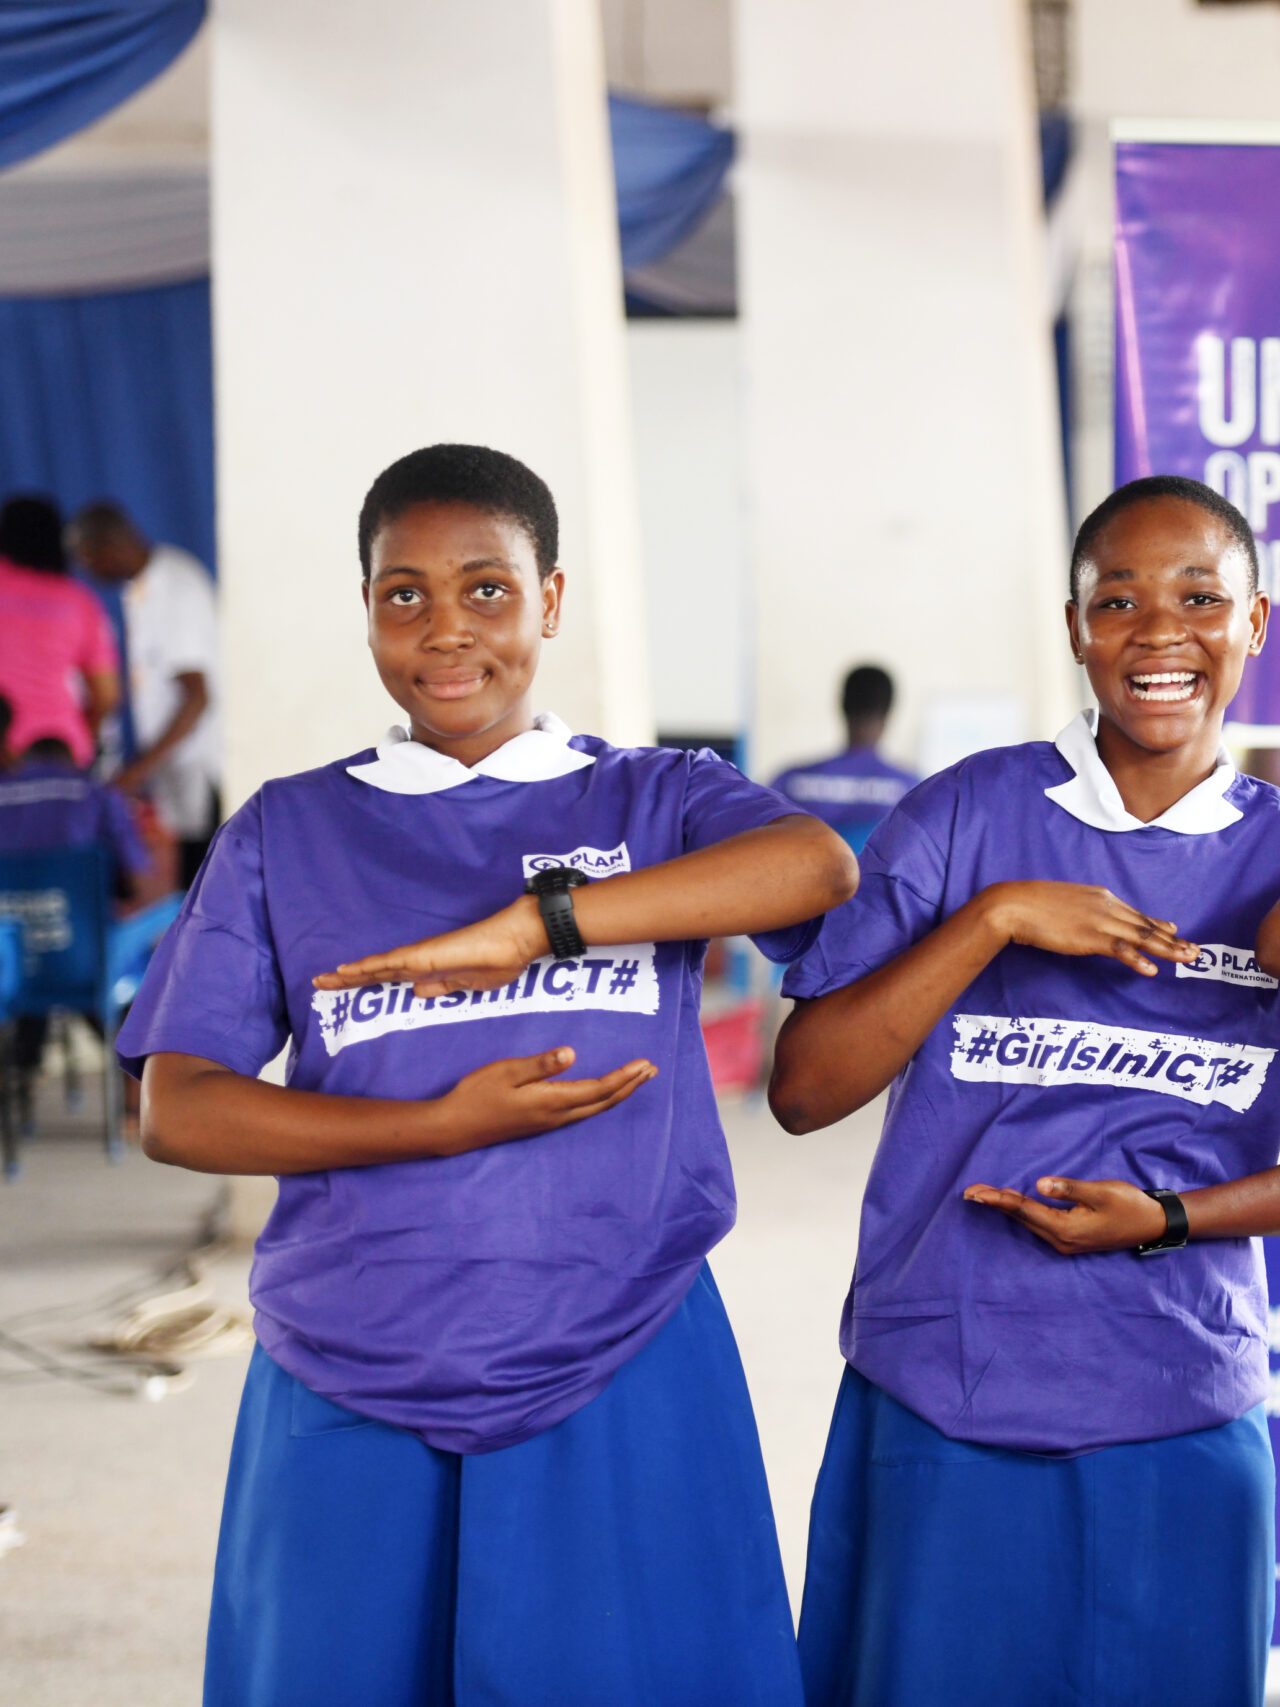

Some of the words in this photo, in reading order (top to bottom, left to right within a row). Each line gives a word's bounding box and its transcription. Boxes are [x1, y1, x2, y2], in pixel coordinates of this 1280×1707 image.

[569, 850, 623, 867] PLAN
[1221, 951, 1265, 974] PLA
[1221, 969, 1274, 984] INTERNATIONAL
[966, 1029, 1254, 1091] #GirlsInICT#
